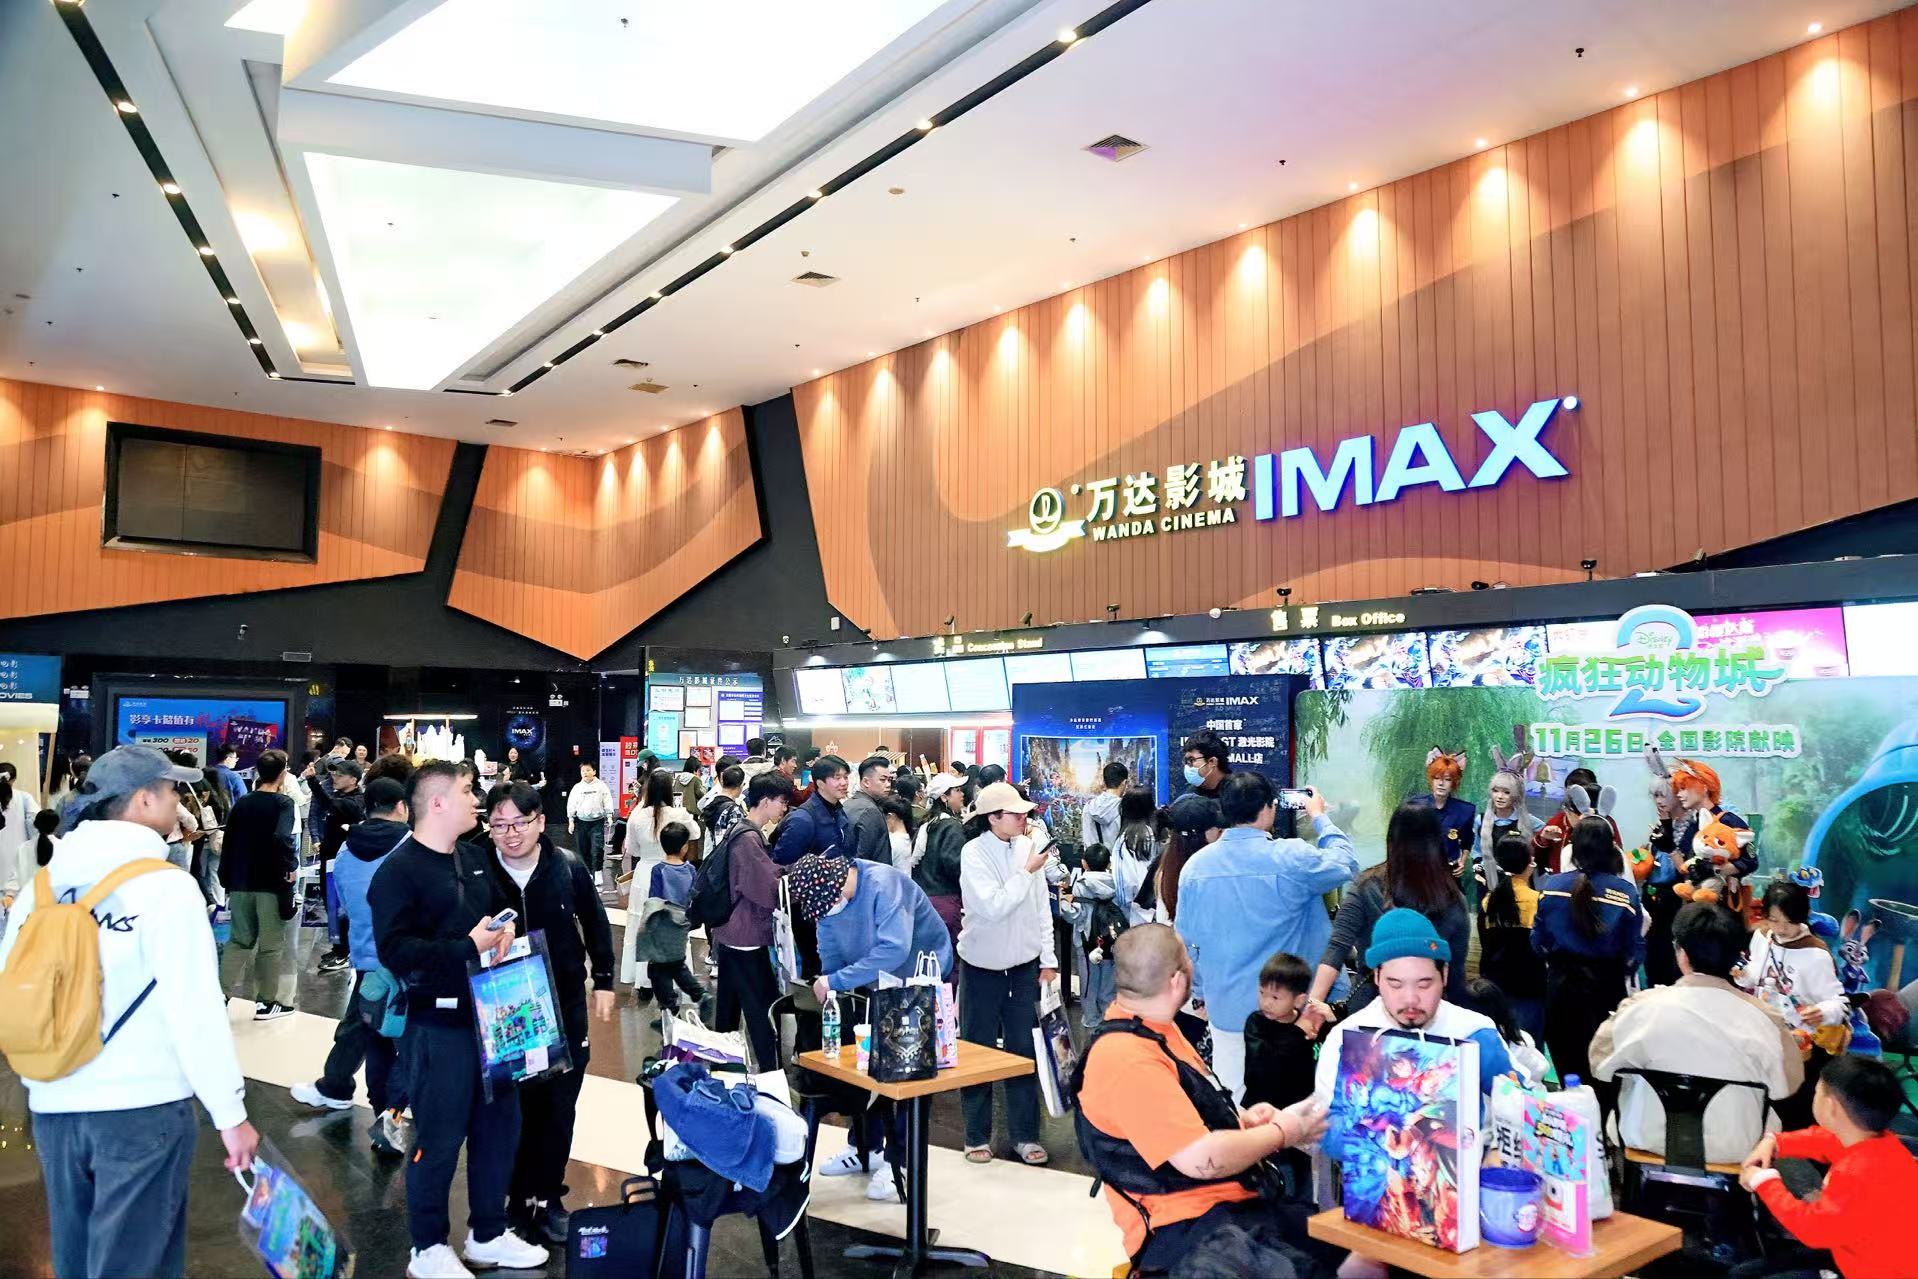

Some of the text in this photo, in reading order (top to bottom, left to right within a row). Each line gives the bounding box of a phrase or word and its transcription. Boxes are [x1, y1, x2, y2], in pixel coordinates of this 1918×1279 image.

[1255, 398, 1570, 521] IMAX
[1086, 456, 1248, 522] 万达影城
[1093, 508, 1236, 542] WANDA CINEMA
[1361, 612, 1405, 625] Office
[1537, 645, 1785, 696] 疯狂动物城
[1225, 696, 1259, 705] IMAX
[511, 727, 535, 735] IMAX
